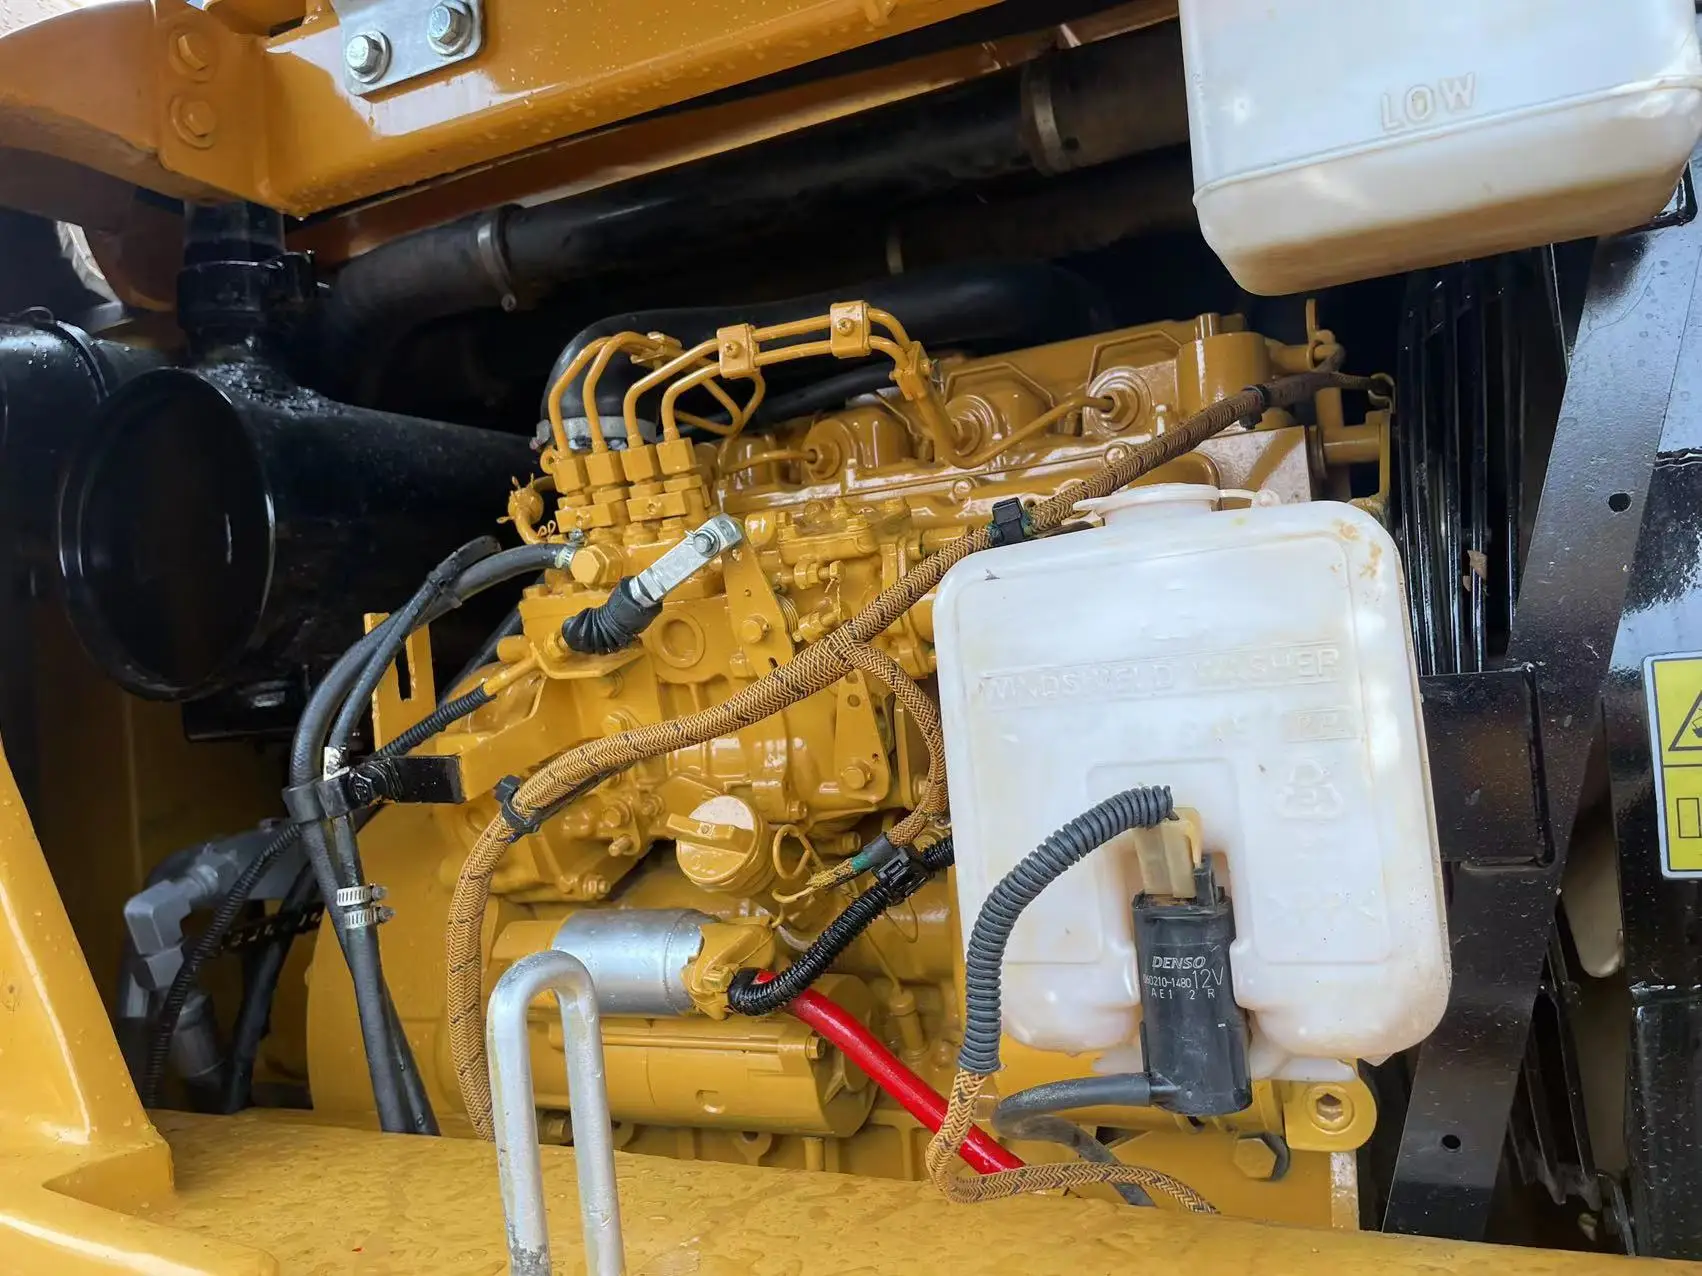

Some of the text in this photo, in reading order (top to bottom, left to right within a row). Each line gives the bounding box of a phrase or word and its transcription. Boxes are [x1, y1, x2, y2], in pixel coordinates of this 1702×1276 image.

[1380, 71, 1476, 132] LOW
[1152, 955, 1206, 970] DENSO
[1192, 966, 1224, 989] 12V
